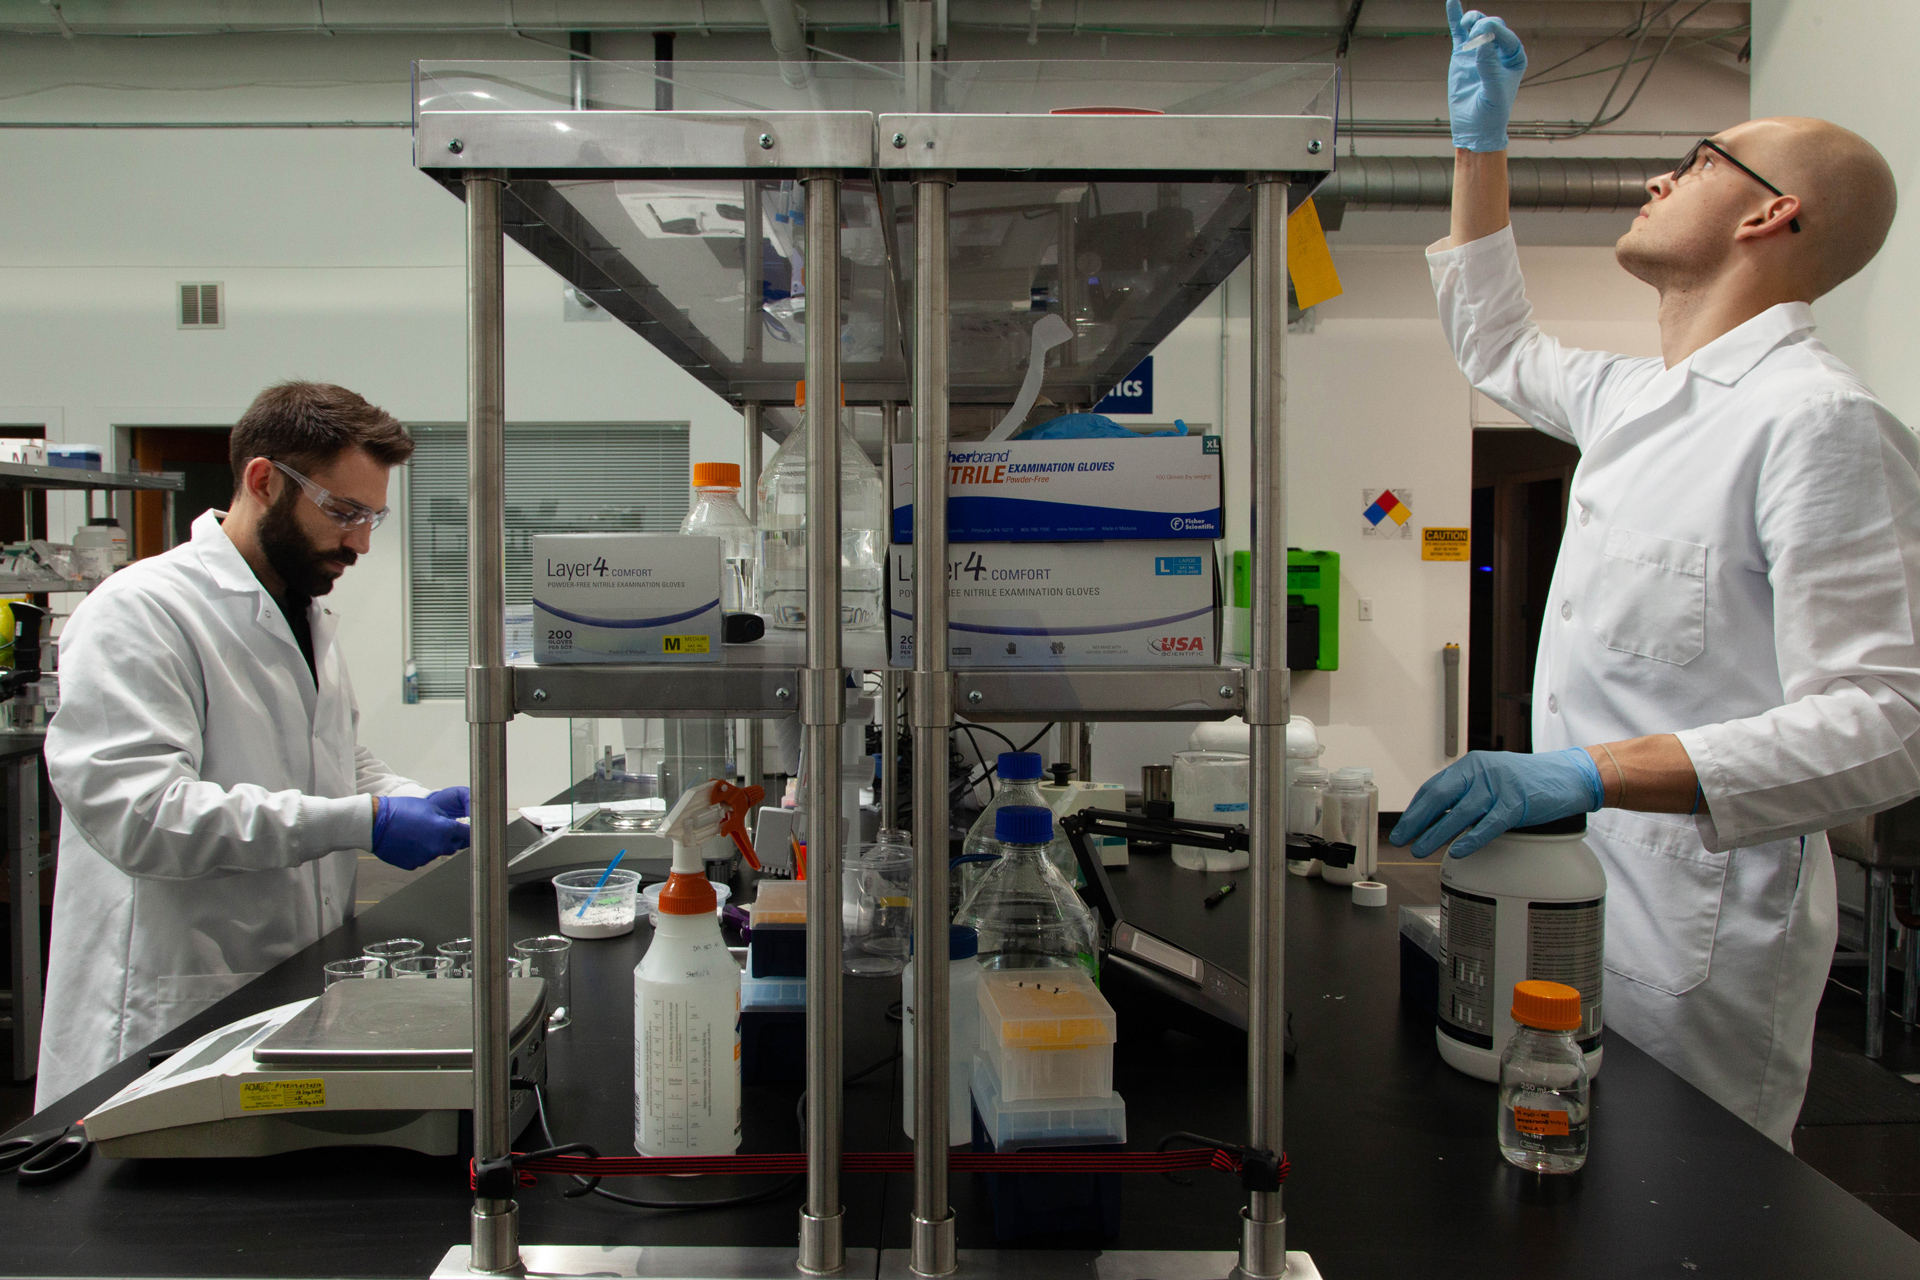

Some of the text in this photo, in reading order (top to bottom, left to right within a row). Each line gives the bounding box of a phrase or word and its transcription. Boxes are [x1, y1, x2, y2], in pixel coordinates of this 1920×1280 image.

[13, 452, 28, 465] M
[948, 450, 1010, 464] herbrand
[1008, 461, 1115, 473] EXAMINATION GLOVES
[948, 465, 1006, 485] TRILE
[1006, 475, 1050, 484] Powder-Free
[1426, 531, 1467, 540] CAUTION
[547, 556, 653, 581] Layer4 COMFORT
[1160, 559, 1170, 573] L
[991, 568, 1051, 580] COMFORT
[963, 588, 997, 597] NITRILE
[999, 588, 1063, 597] EXAMINATION
[1065, 587, 1100, 596] GLOVES
[547, 630, 573, 640] 200
[665, 638, 681, 651] M
[1161, 636, 1204, 651] USA
[1521, 1082, 1535, 1092] 250
